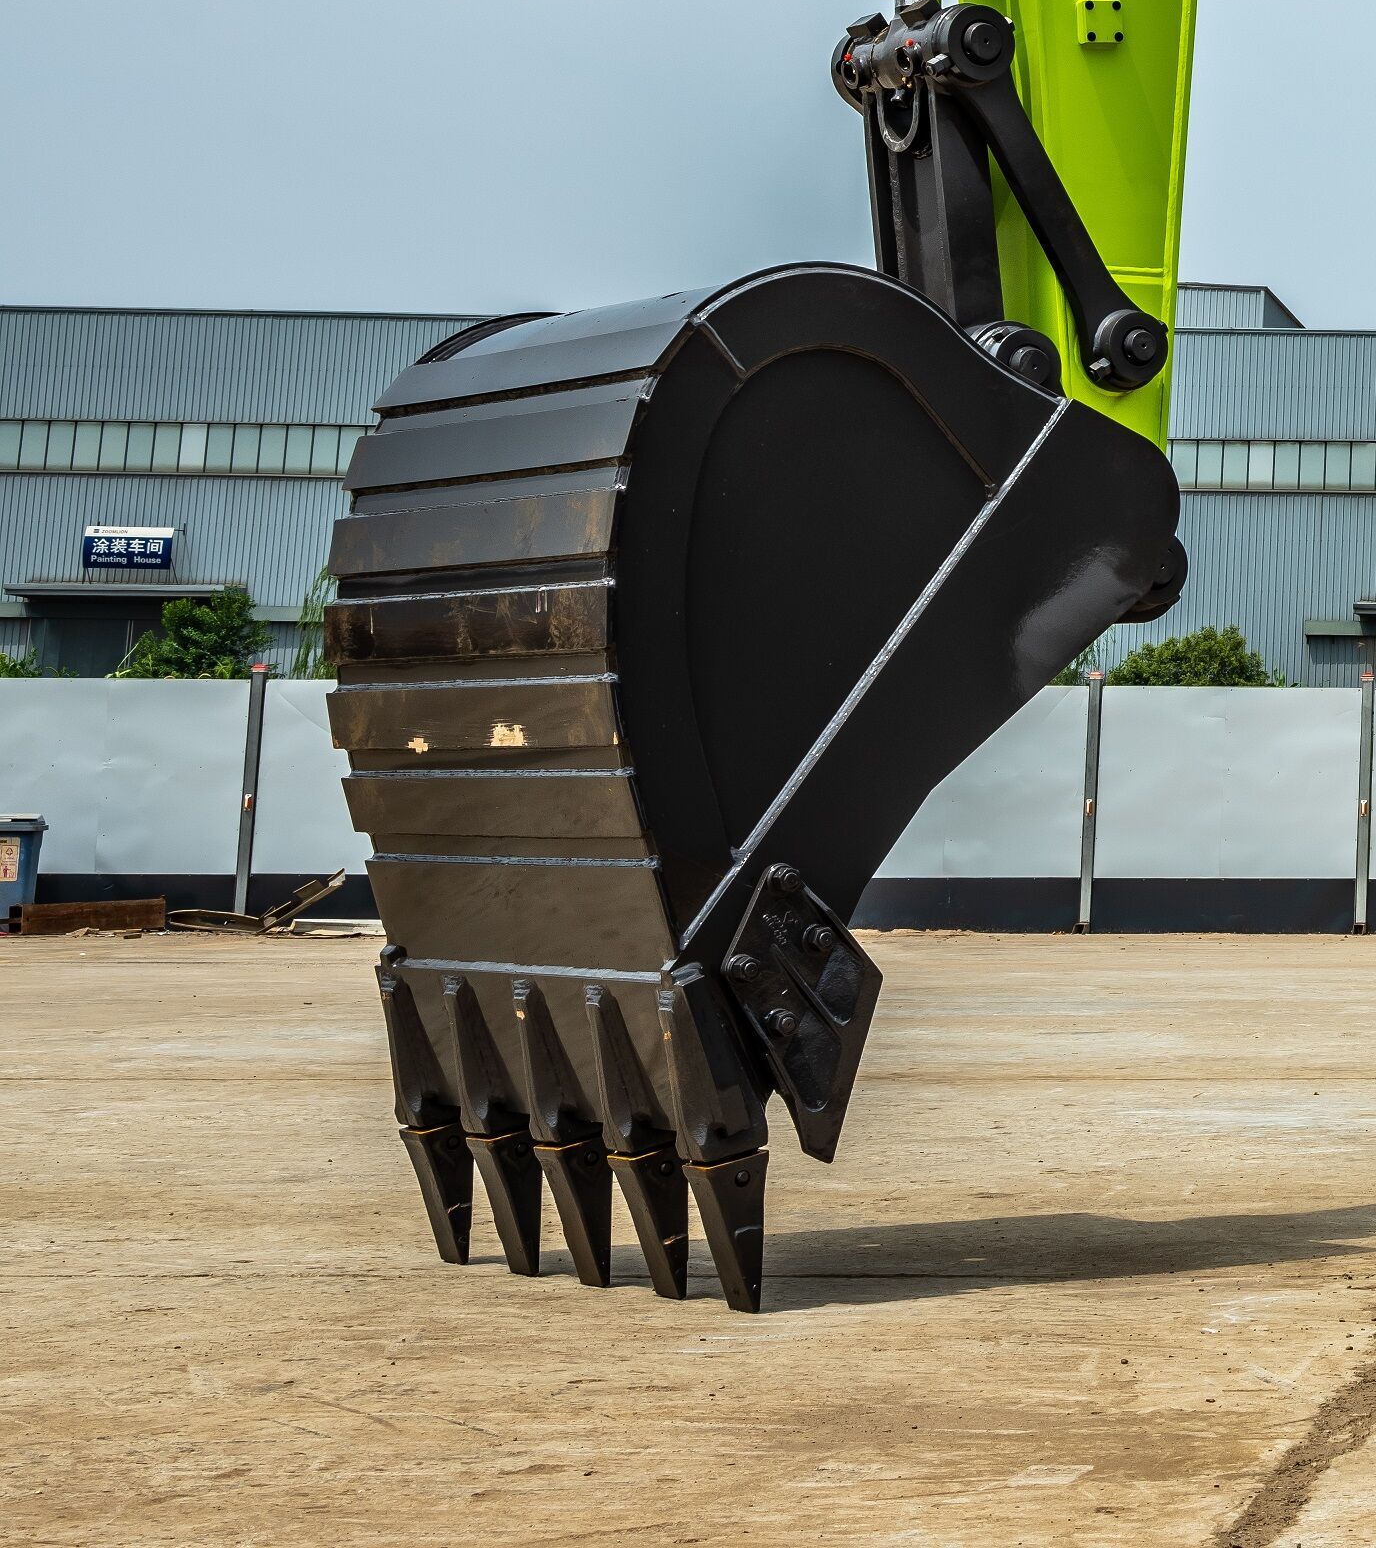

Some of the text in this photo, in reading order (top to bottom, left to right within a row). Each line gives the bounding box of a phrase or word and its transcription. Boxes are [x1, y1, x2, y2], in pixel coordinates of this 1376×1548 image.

[92, 538, 164, 554] 涂装车间
[90, 554, 162, 564] Painting House
